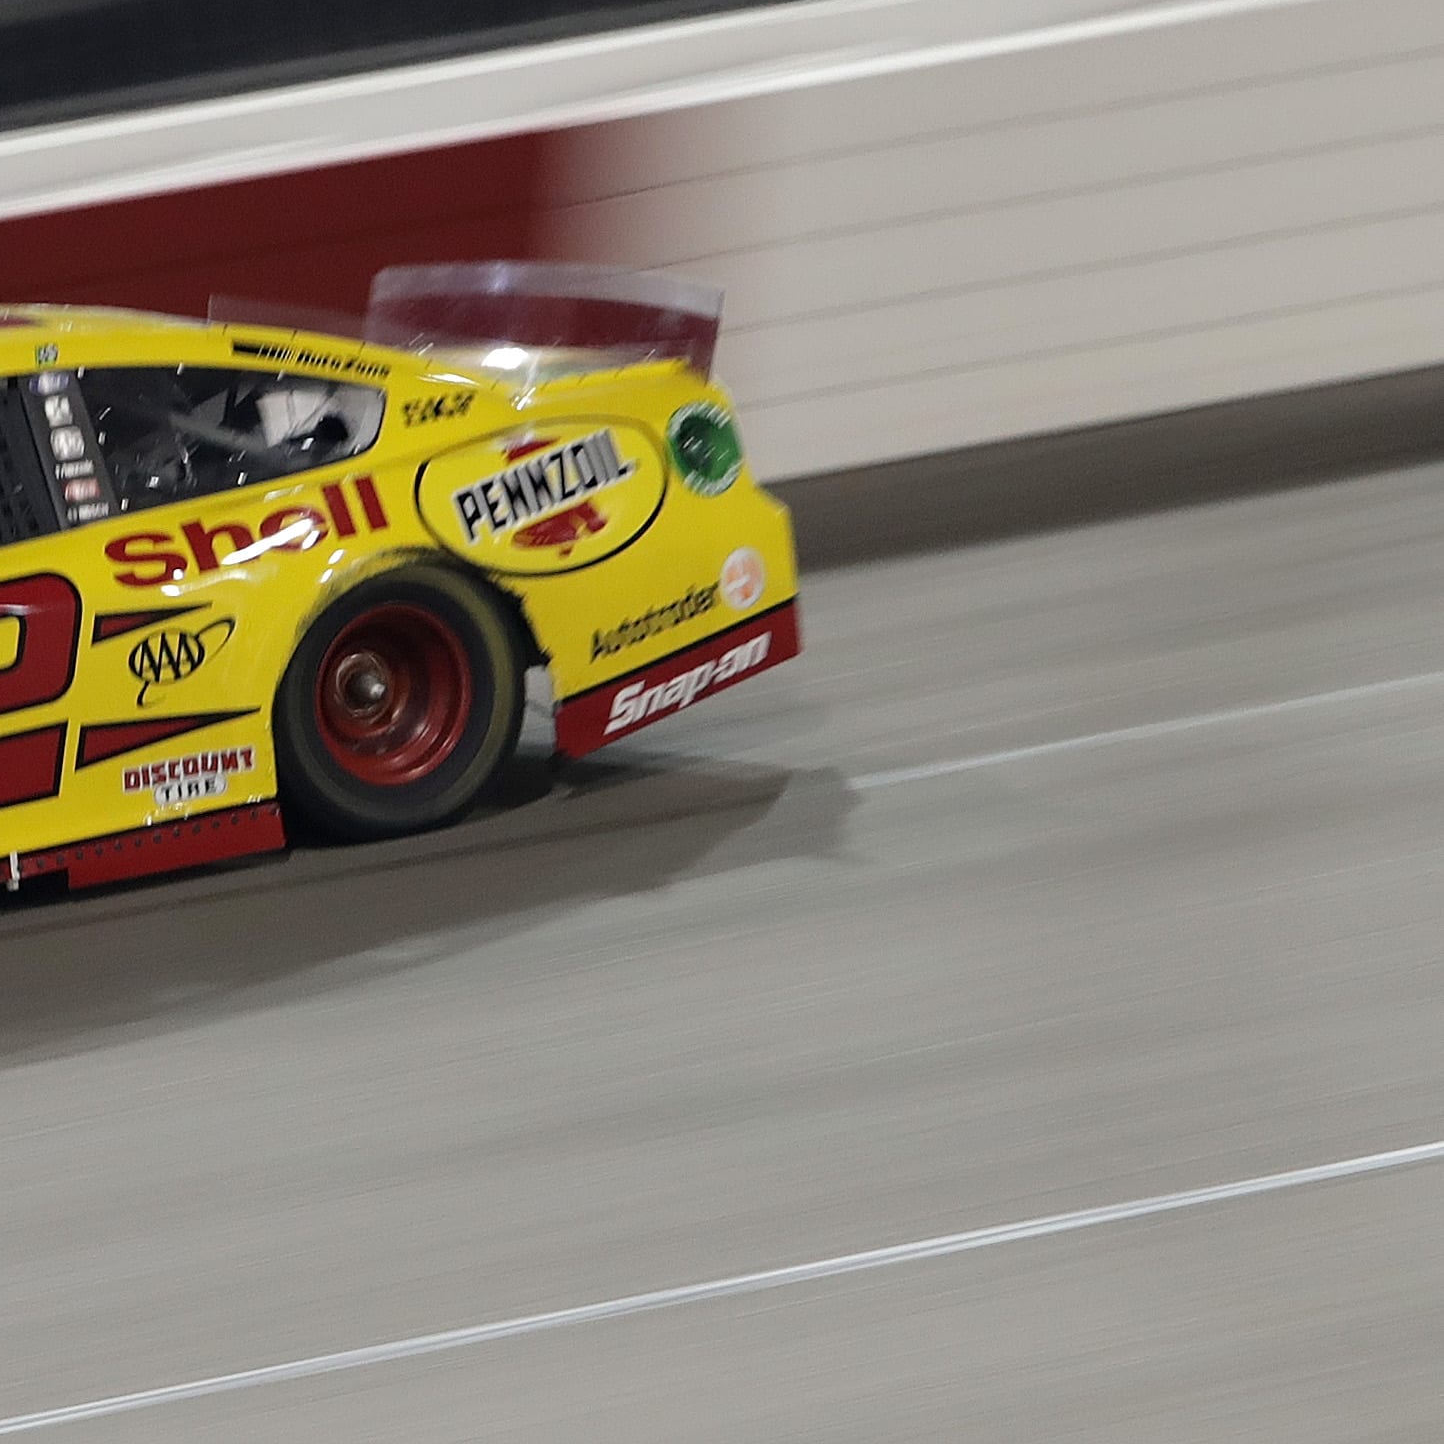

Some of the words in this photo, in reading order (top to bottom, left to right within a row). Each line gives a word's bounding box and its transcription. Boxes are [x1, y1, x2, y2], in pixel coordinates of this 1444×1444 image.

[454, 427, 638, 545] PENNZOIL
[104, 472, 389, 588] Shell
[135, 630, 202, 684] AAA
[123, 746, 255, 792] DISCOUNT
[160, 777, 217, 803] TIRE
